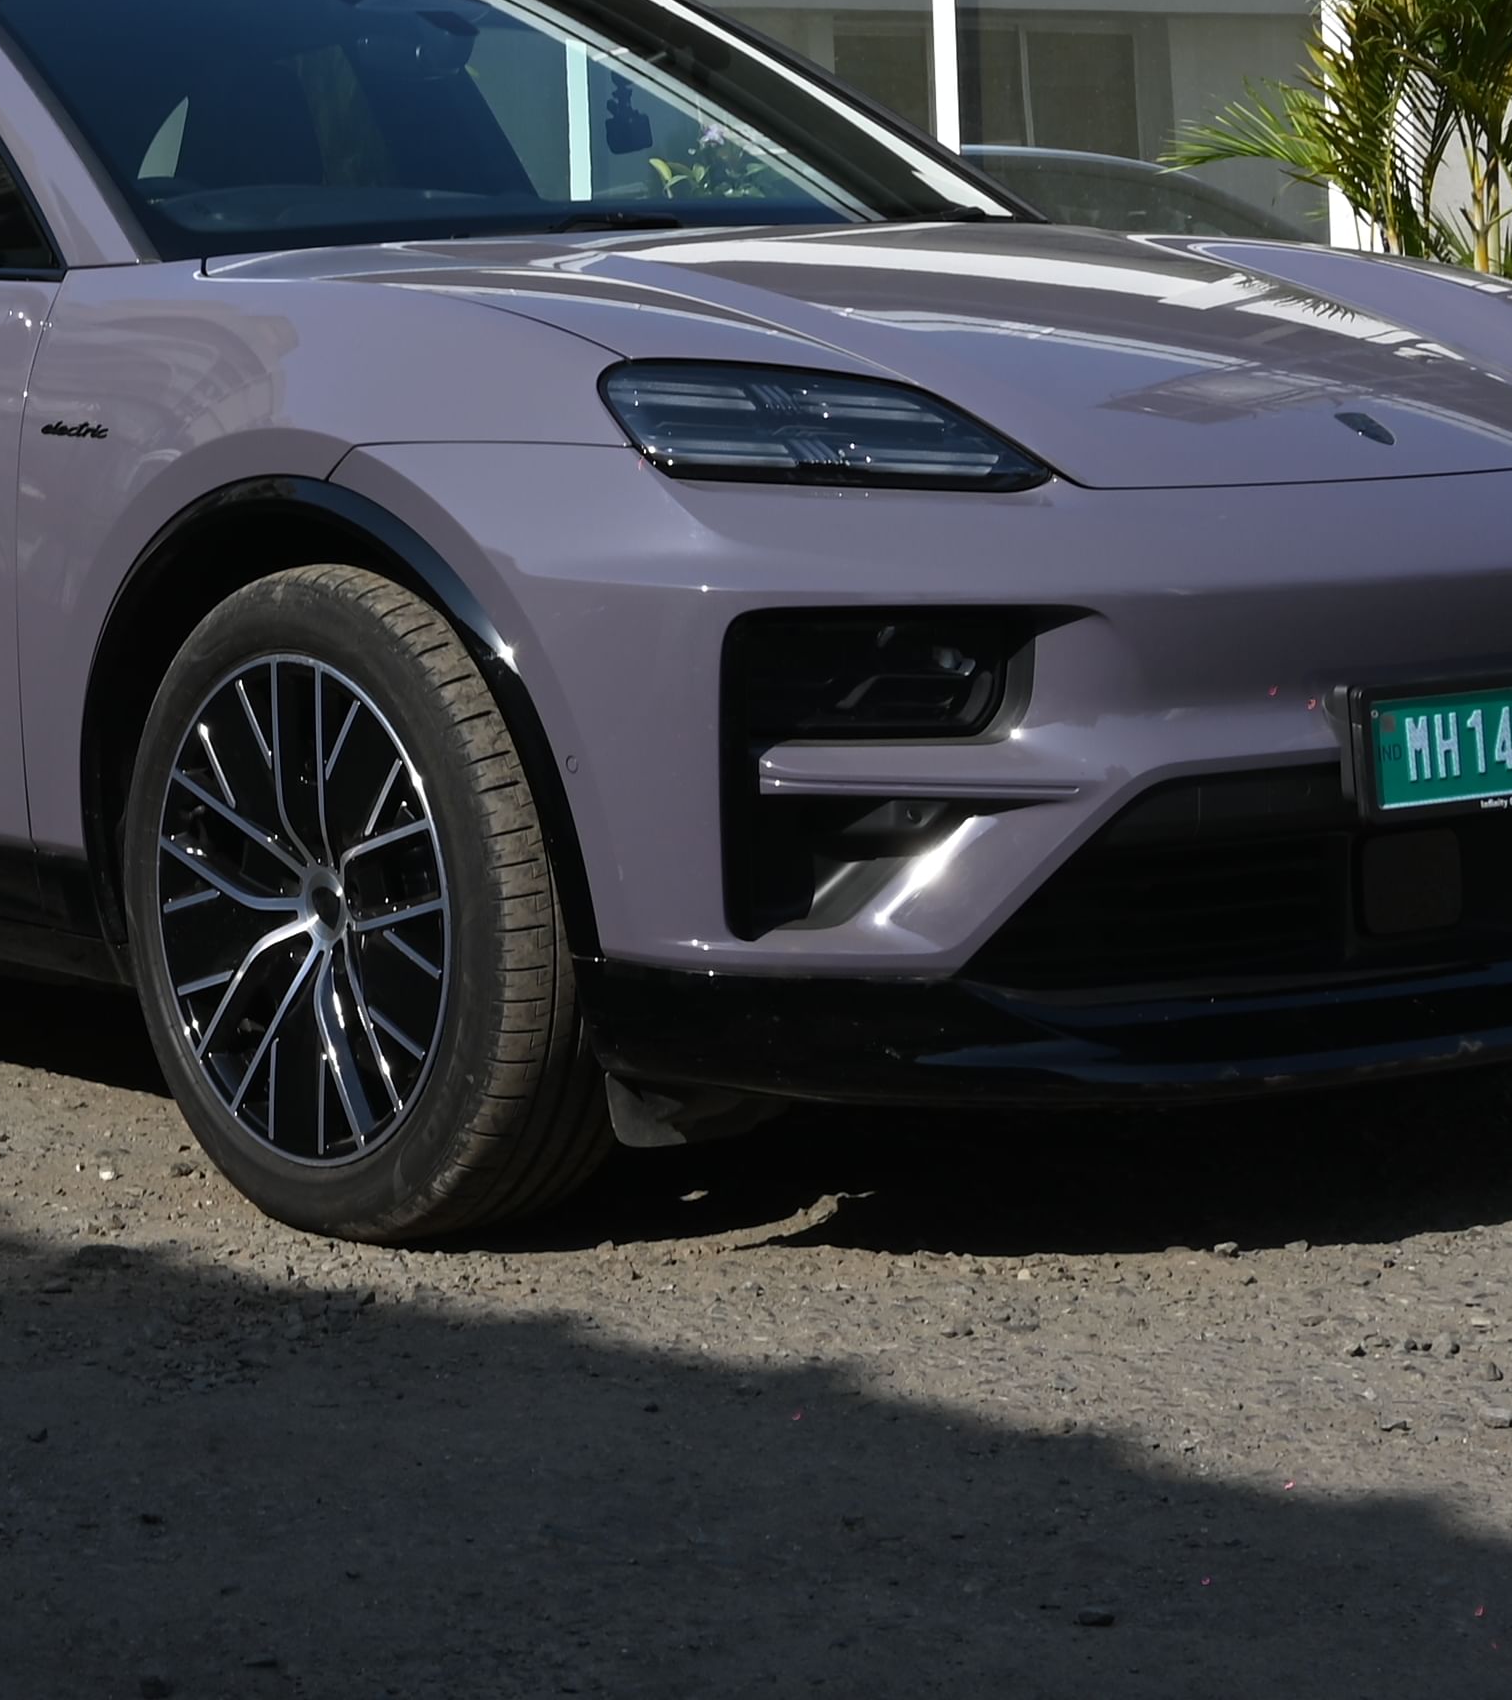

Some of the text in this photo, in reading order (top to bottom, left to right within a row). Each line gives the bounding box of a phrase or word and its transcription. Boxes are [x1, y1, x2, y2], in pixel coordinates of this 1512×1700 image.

[41, 420, 109, 439] electric
[1378, 743, 1402, 765] IND
[1480, 798, 1508, 809] Infinity
